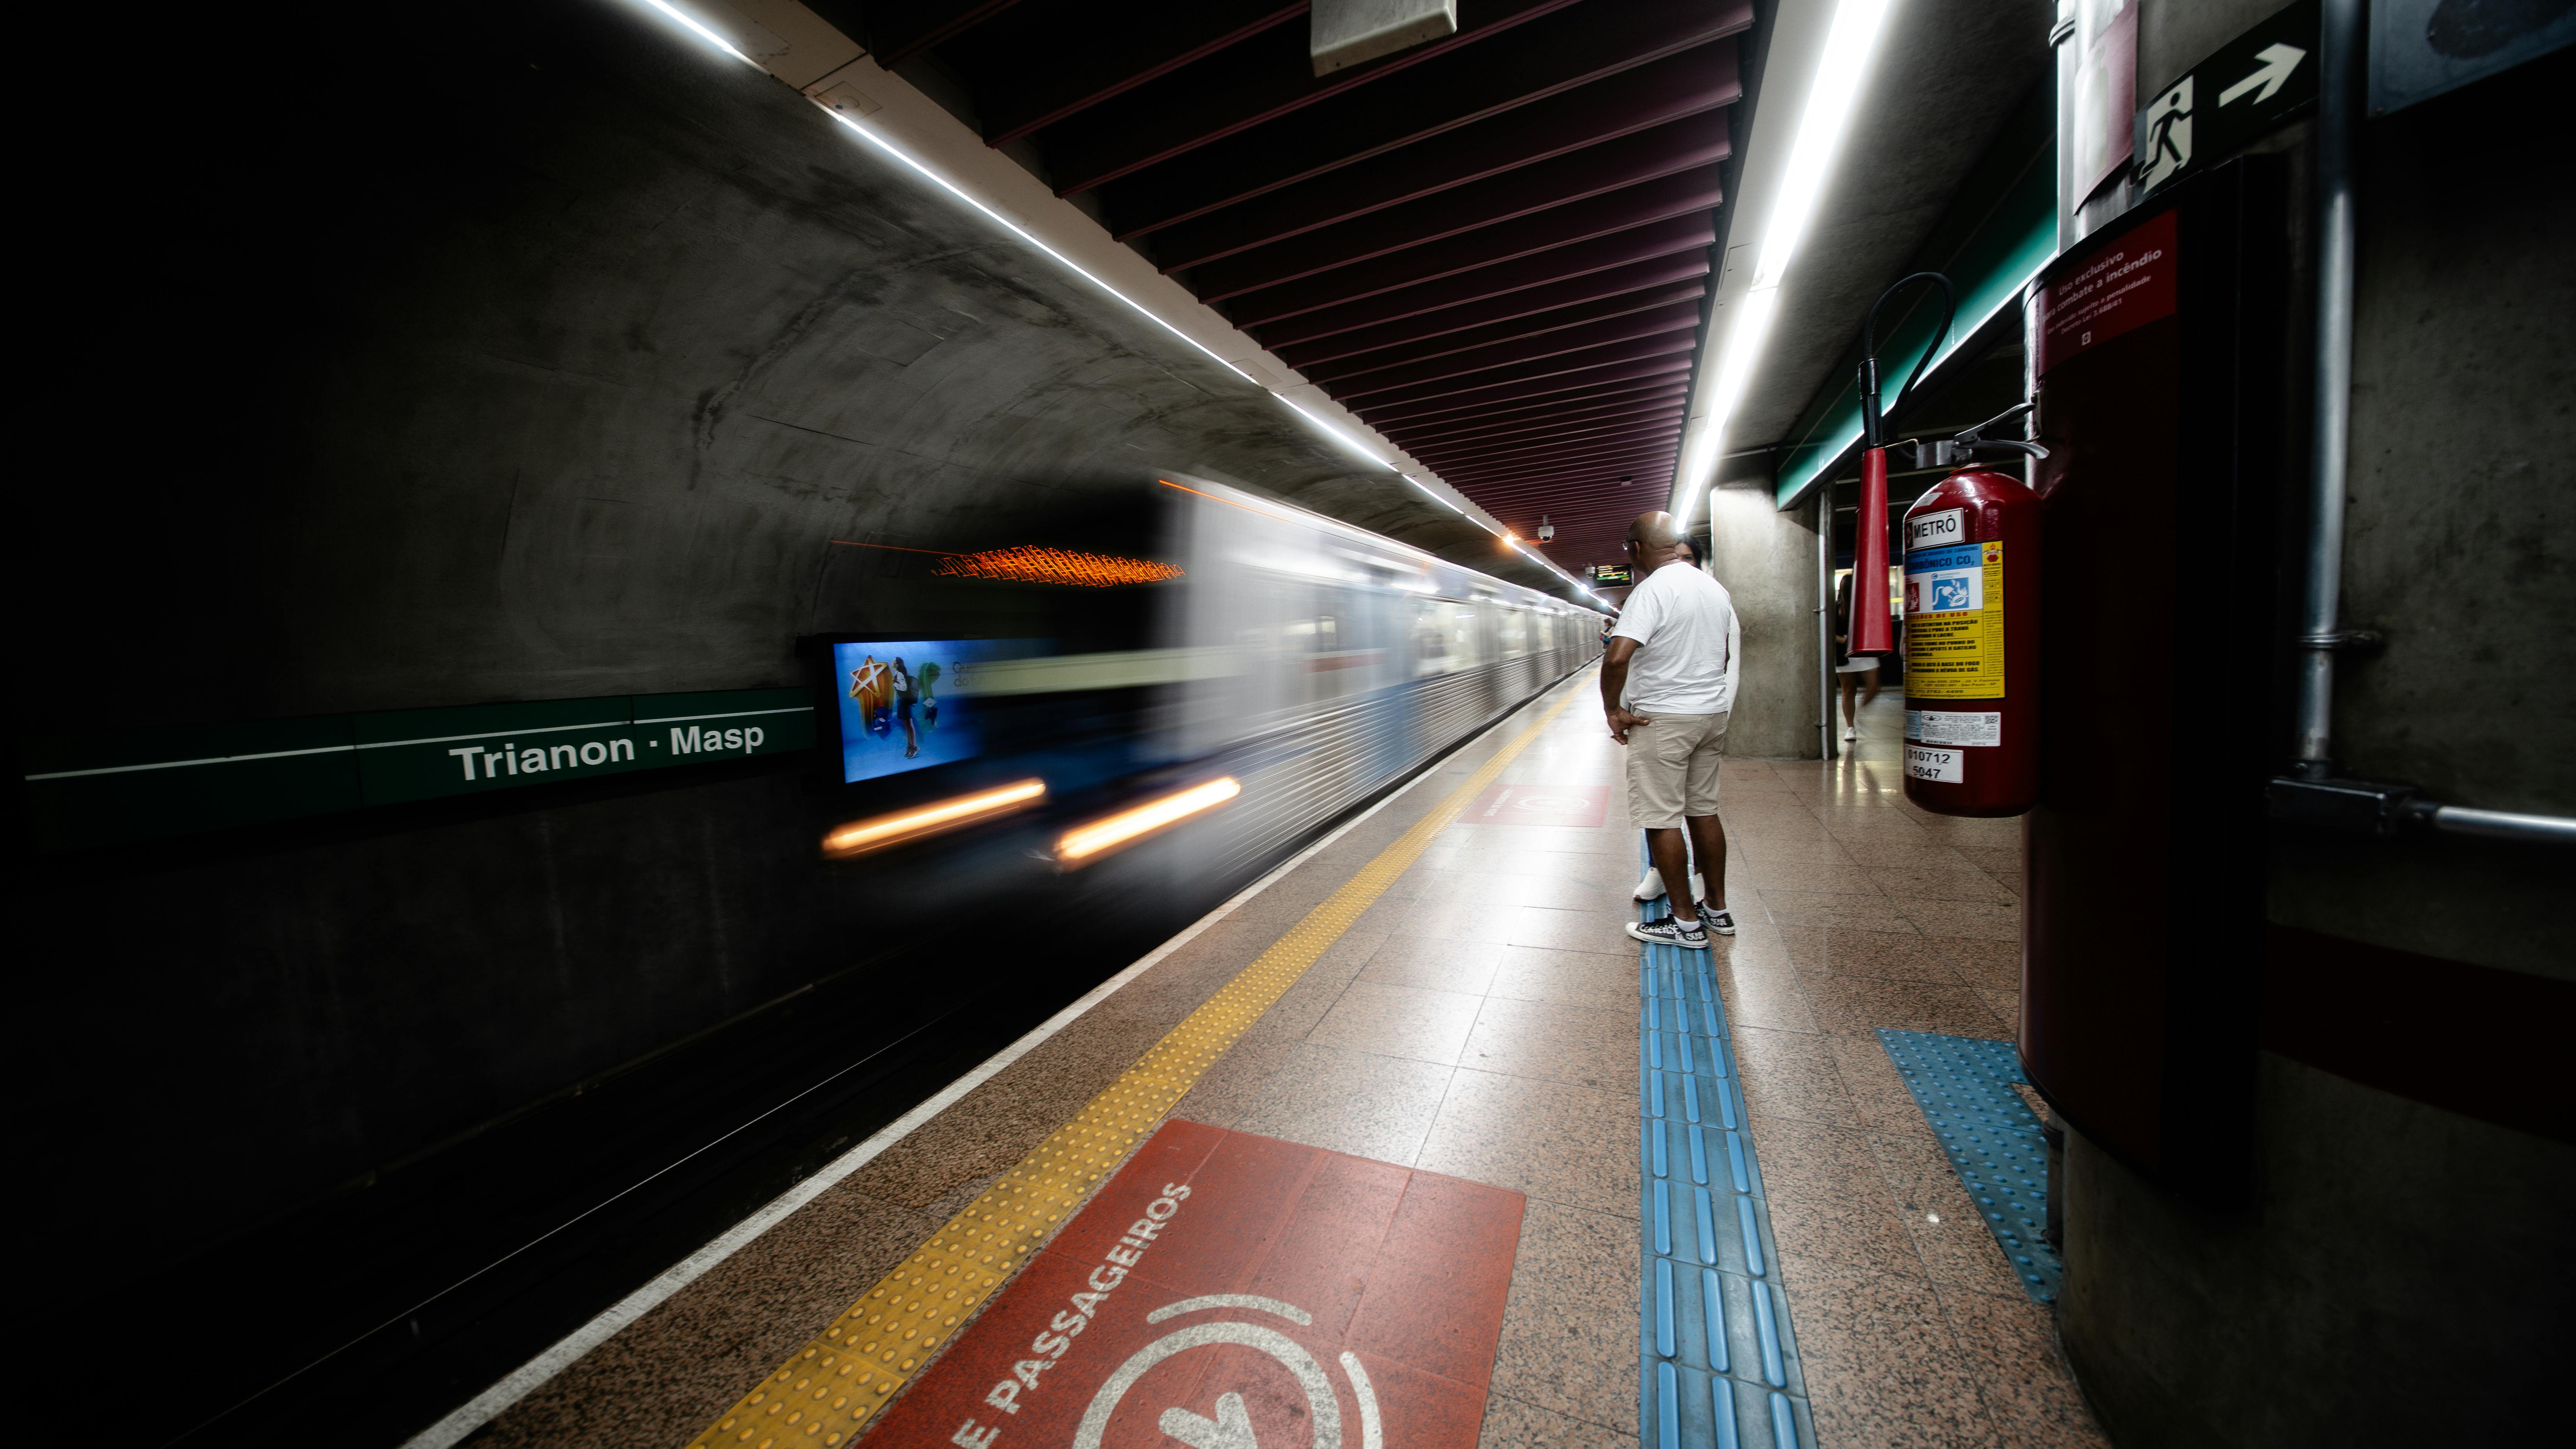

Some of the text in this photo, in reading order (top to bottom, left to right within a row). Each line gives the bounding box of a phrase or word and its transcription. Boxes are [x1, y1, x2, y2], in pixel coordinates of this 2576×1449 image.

[2043, 249, 2162, 324] para combate a incêndio
[2059, 252, 2124, 296] Uso exclusivo
[2107, 275, 2151, 302] penalidade
[2082, 312, 2092, 323] Lei
[1914, 515, 1956, 538] METRÔ
[448, 738, 635, 780] Trianon
[670, 725, 764, 755] Masp
[1909, 750, 1950, 764] 010712
[1913, 766, 1941, 778] 5047
[985, 1182, 1192, 1414] PASSAGEIROS
